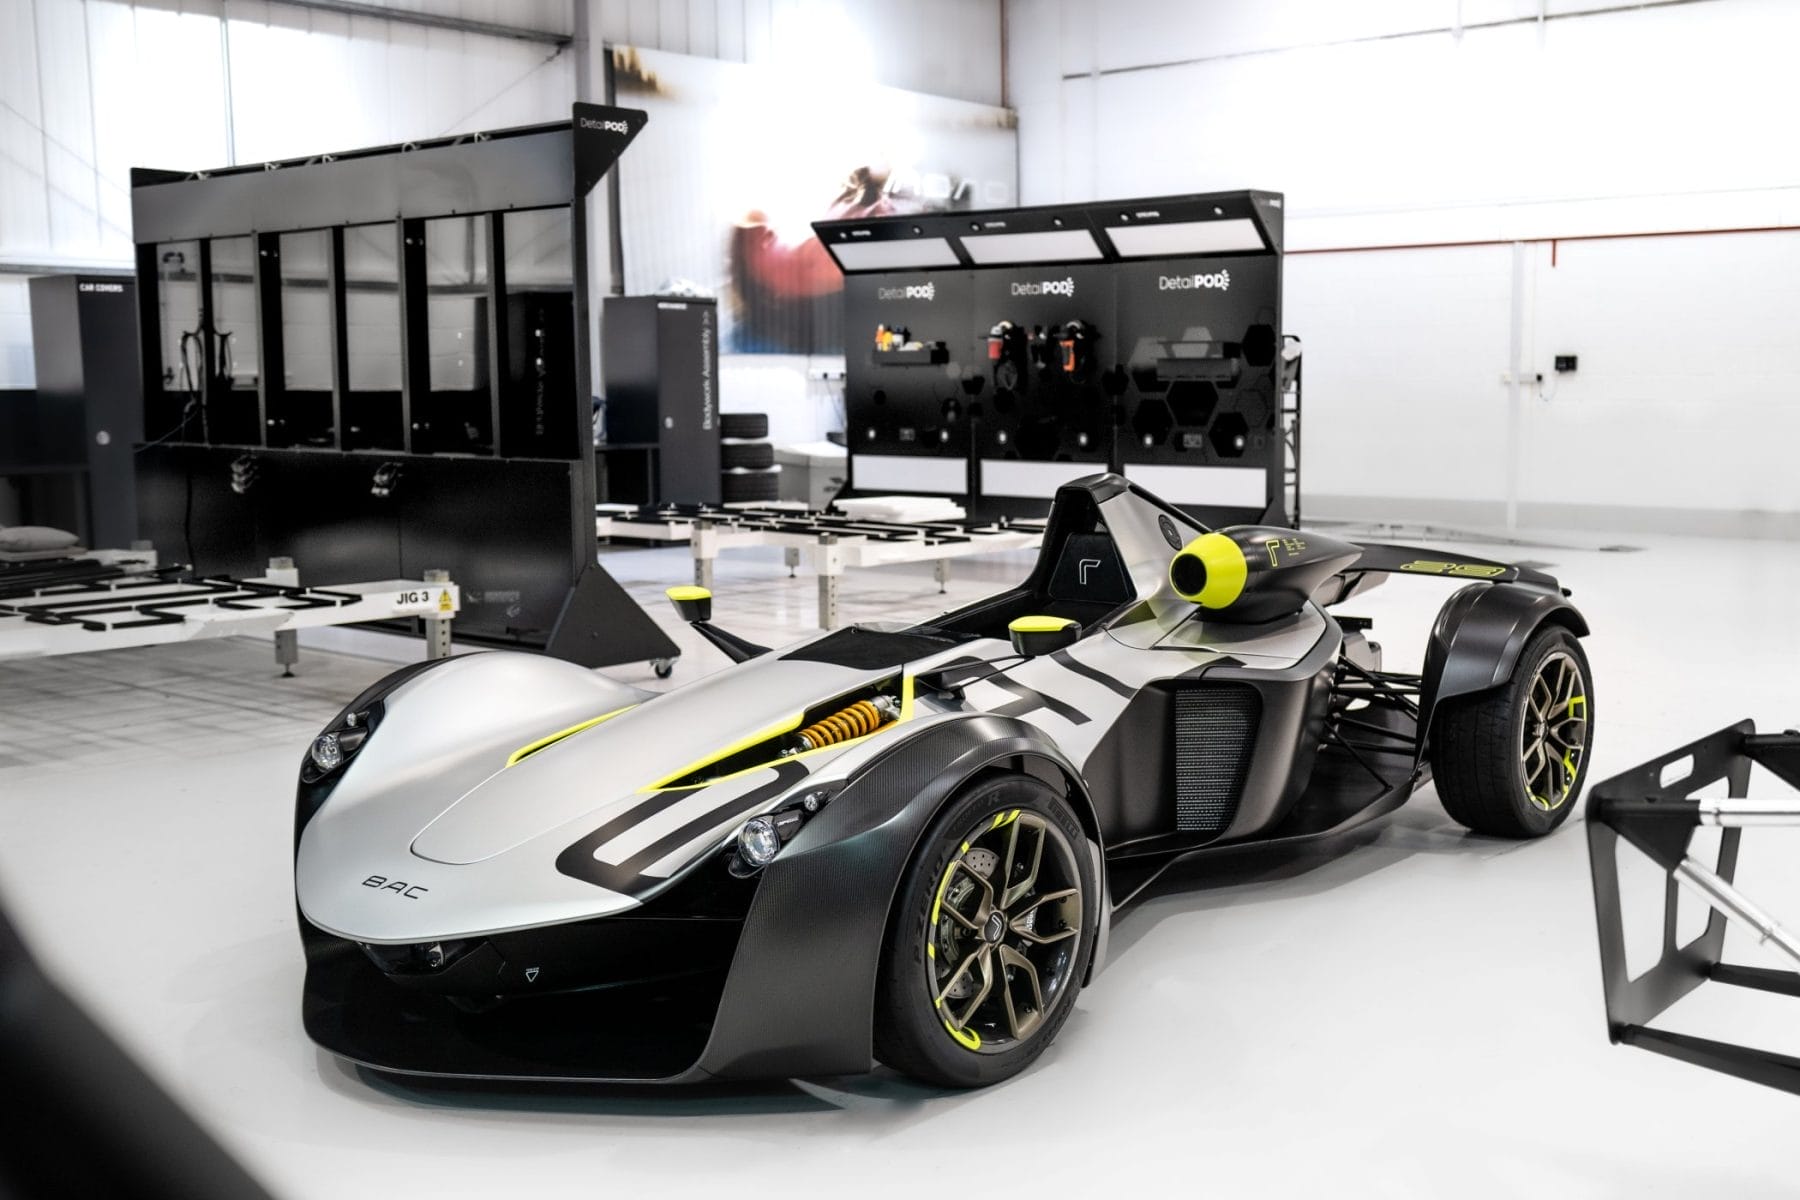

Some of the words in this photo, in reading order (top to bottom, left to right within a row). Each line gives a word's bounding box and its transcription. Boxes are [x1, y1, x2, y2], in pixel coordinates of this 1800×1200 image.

[1011, 277, 1074, 297] DetailPOD
[1159, 269, 1230, 291] DetailPOD
[878, 282, 935, 300] DetailPOD
[396, 592, 418, 605] JIG
[421, 591, 429, 602] 3
[362, 875, 429, 900] BAC
